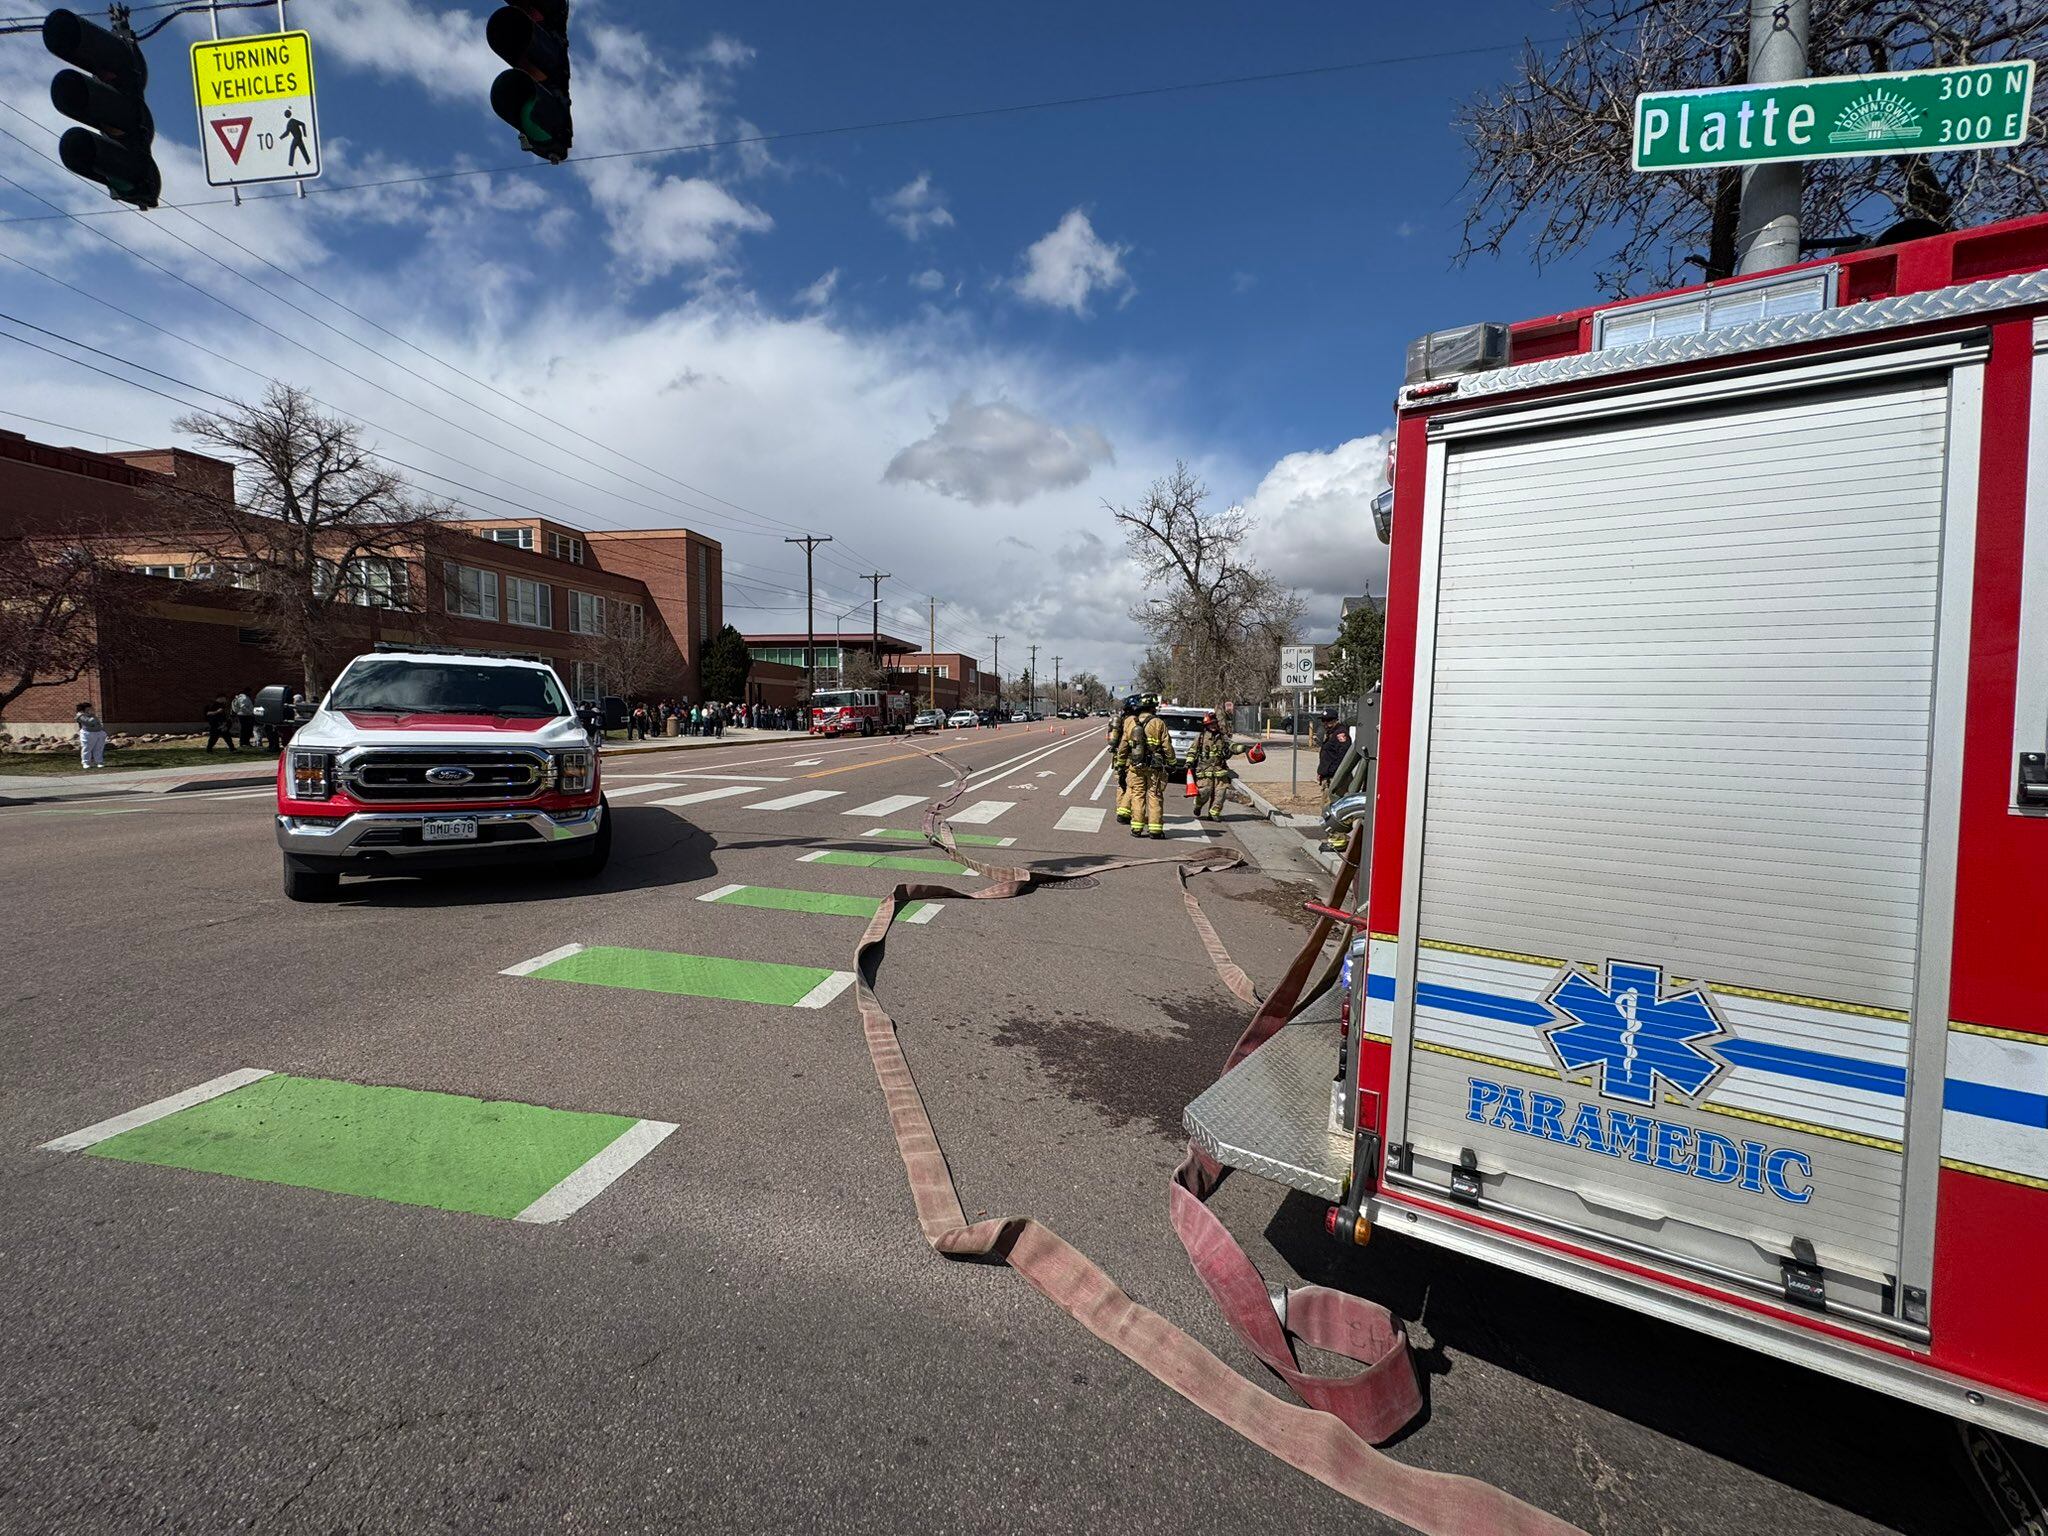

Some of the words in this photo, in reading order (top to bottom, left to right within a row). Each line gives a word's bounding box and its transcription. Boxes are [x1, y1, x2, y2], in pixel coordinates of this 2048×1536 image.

[213, 45, 290, 72] TURNING
[211, 72, 298, 100] VEHICLES
[1939, 72, 1993, 101] 300
[2004, 70, 2023, 95] N
[1642, 97, 1816, 156] Platte
[1842, 101, 1910, 129] DOWNTOWN
[1938, 115, 1992, 143] 300
[2004, 113, 2018, 137] E
[257, 132, 274, 151] TO
[1286, 675, 1308, 684] ONLY
[438, 771, 461, 779] Ford
[1466, 1077, 1815, 1204] PARAMEDIC
